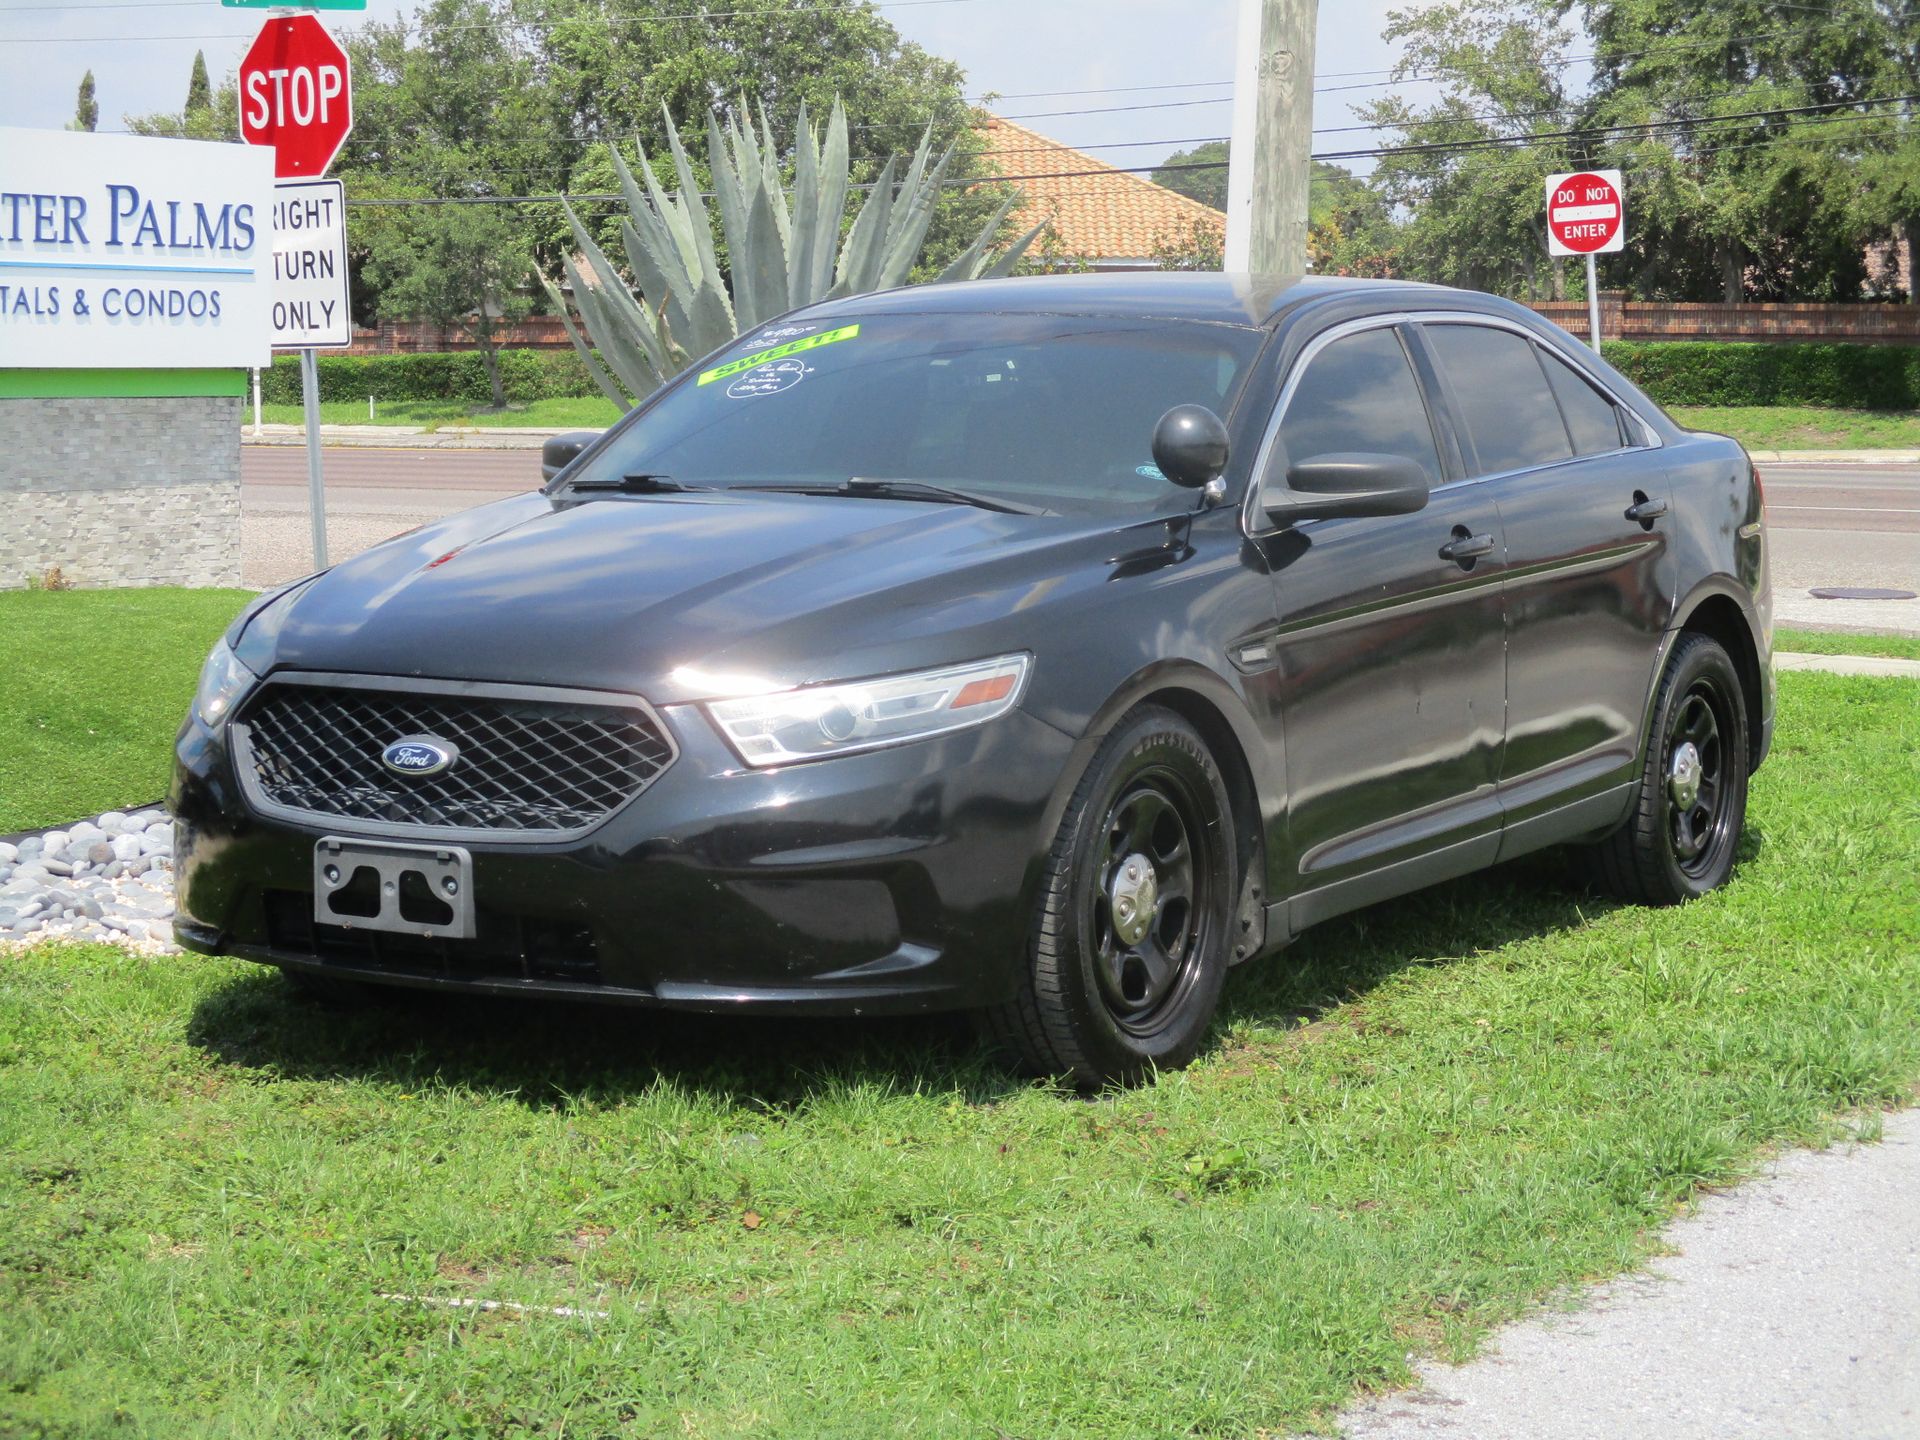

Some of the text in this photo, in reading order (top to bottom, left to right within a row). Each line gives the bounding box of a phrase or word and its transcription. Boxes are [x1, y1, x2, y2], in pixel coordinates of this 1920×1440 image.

[247, 65, 342, 129] STOP
[1558, 187, 1610, 203] DO NOT
[0, 184, 255, 251] TER PALMS
[1564, 224, 1606, 239] ENTER
[272, 249, 334, 281] TURN
[73, 288, 90, 316] &
[103, 287, 221, 318] CONDOS
[272, 299, 336, 331] ONLY
[713, 330, 842, 378] SWEET!
[394, 747, 431, 766] Ford
